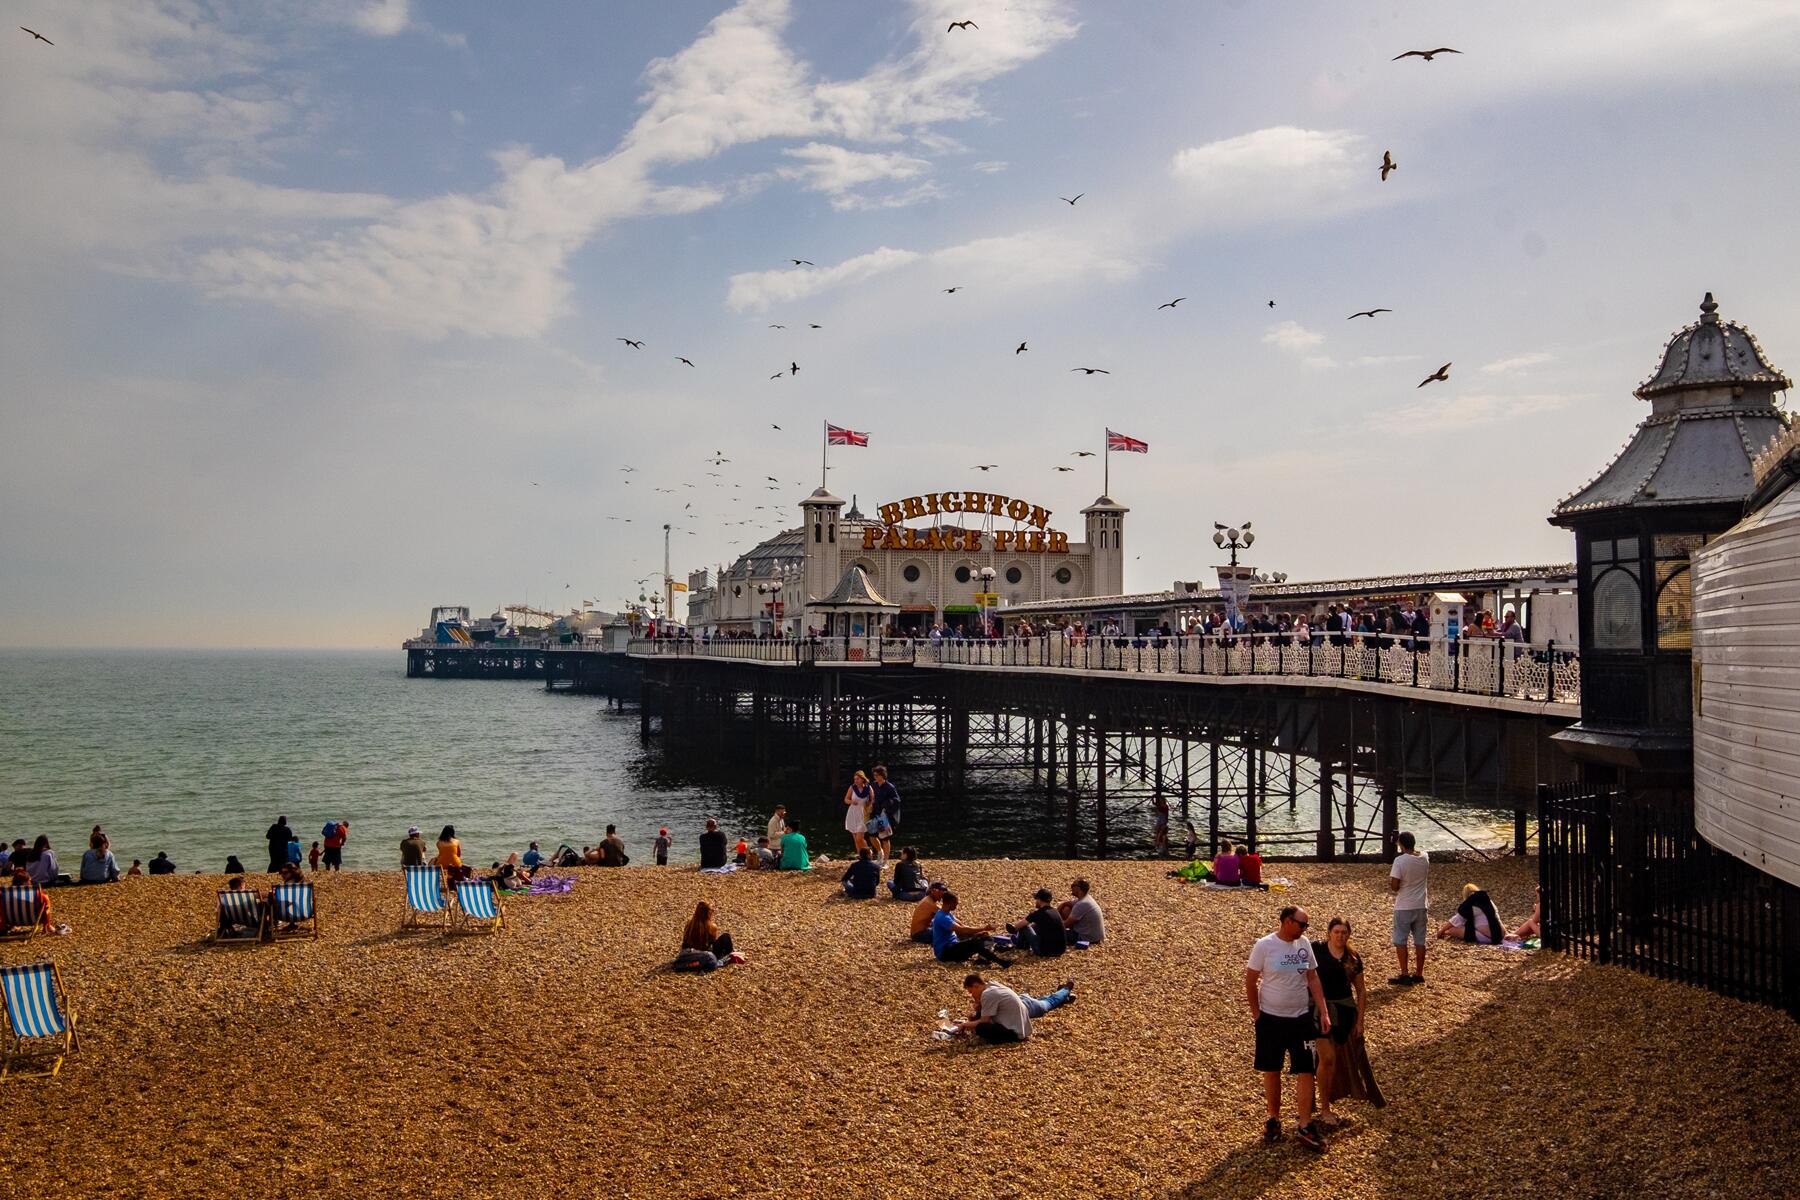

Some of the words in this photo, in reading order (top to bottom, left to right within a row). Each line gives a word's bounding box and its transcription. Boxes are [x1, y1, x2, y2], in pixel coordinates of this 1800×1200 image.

[878, 491, 1052, 530] BRIGHTON
[863, 527, 982, 551] PALACE
[994, 530, 1070, 553] PIER
